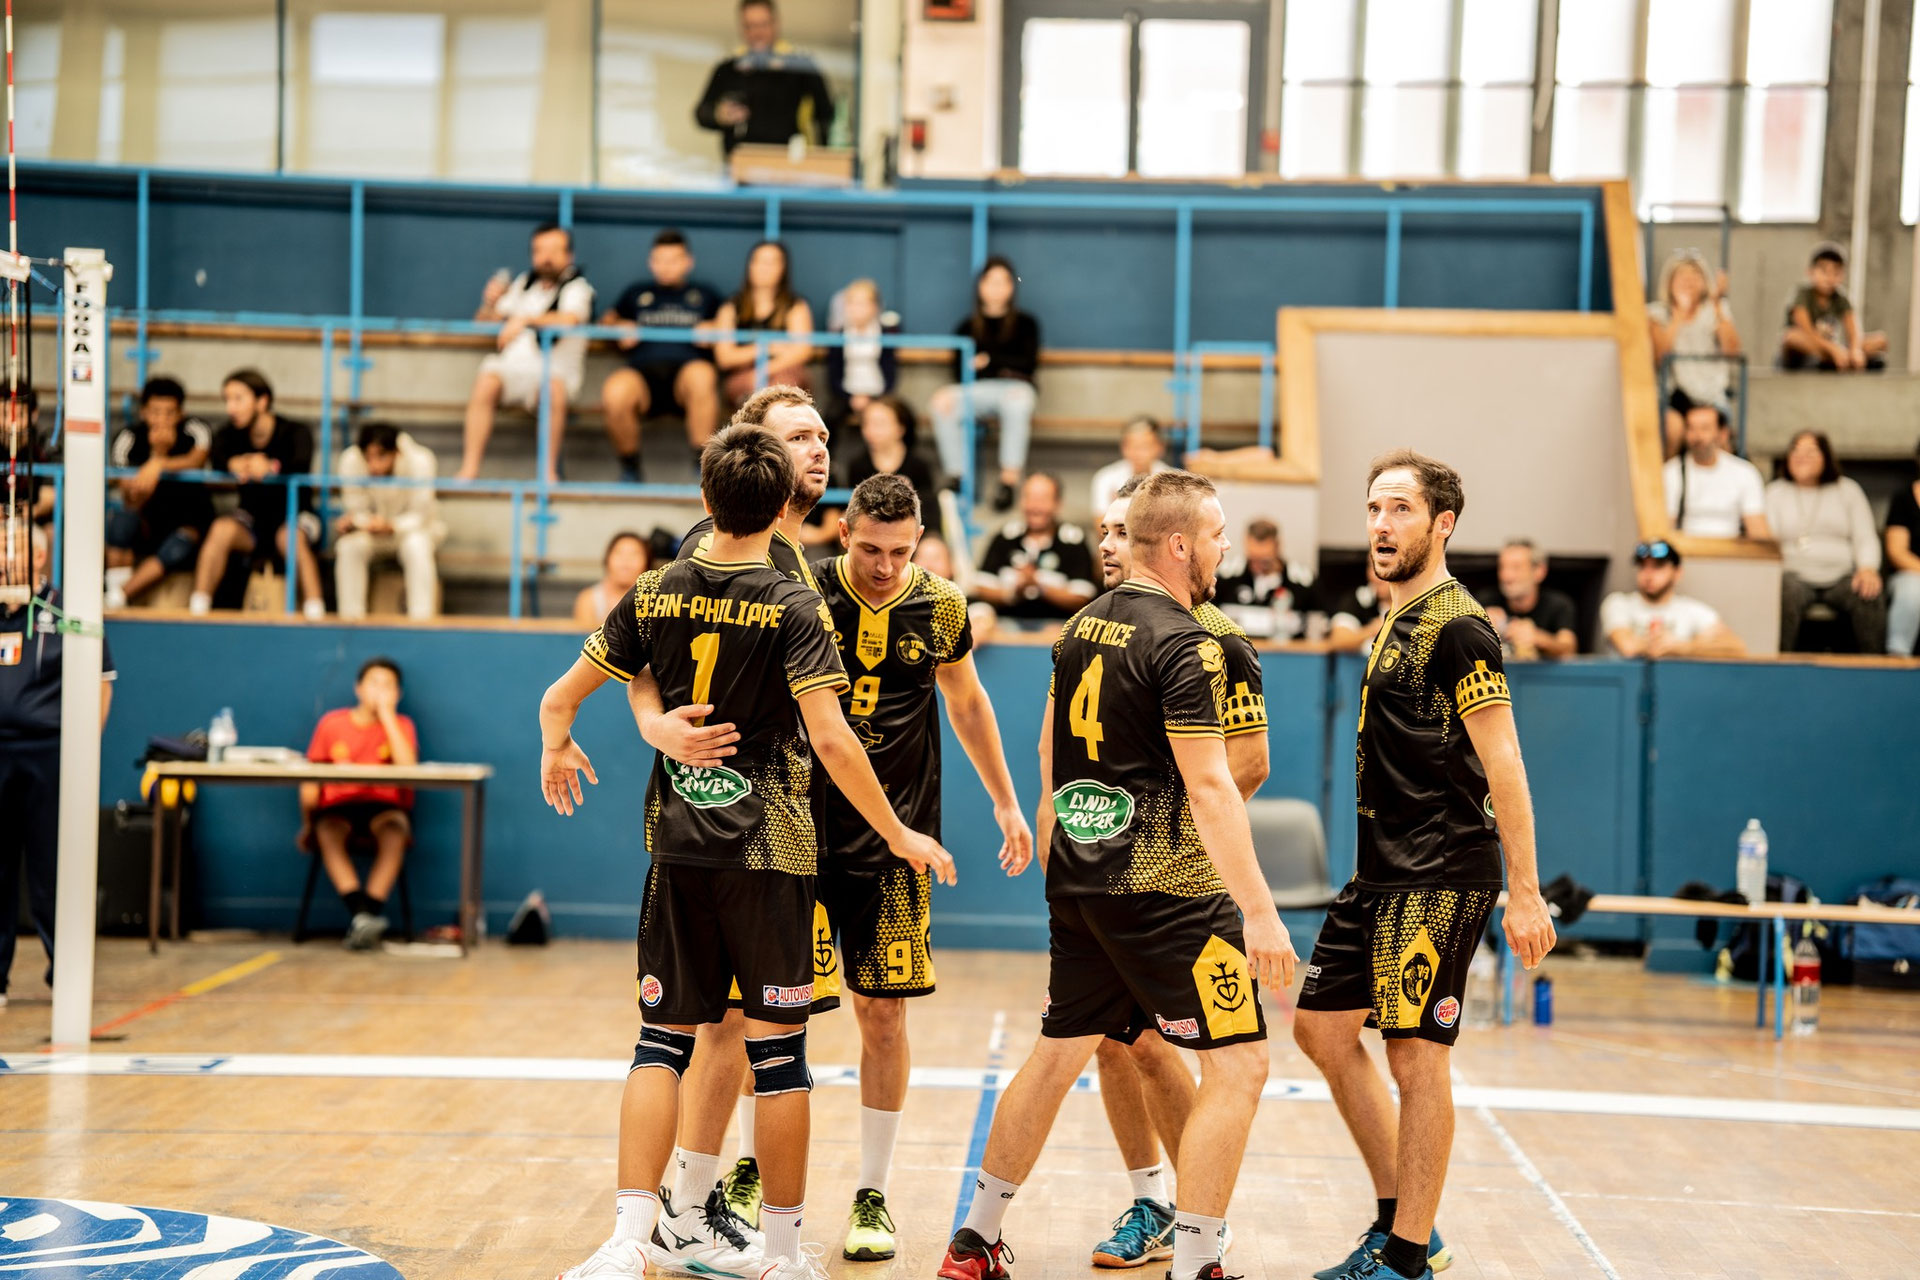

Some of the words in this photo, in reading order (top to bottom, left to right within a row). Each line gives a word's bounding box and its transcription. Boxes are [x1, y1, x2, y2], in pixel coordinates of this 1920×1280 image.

[635, 593, 787, 628] JEAN-PHILIPPE
[690, 632, 720, 727] 1
[849, 675, 881, 716] 9
[1069, 653, 1104, 761] 4
[887, 940, 913, 984] 9
[1438, 1008, 1457, 1018] KING
